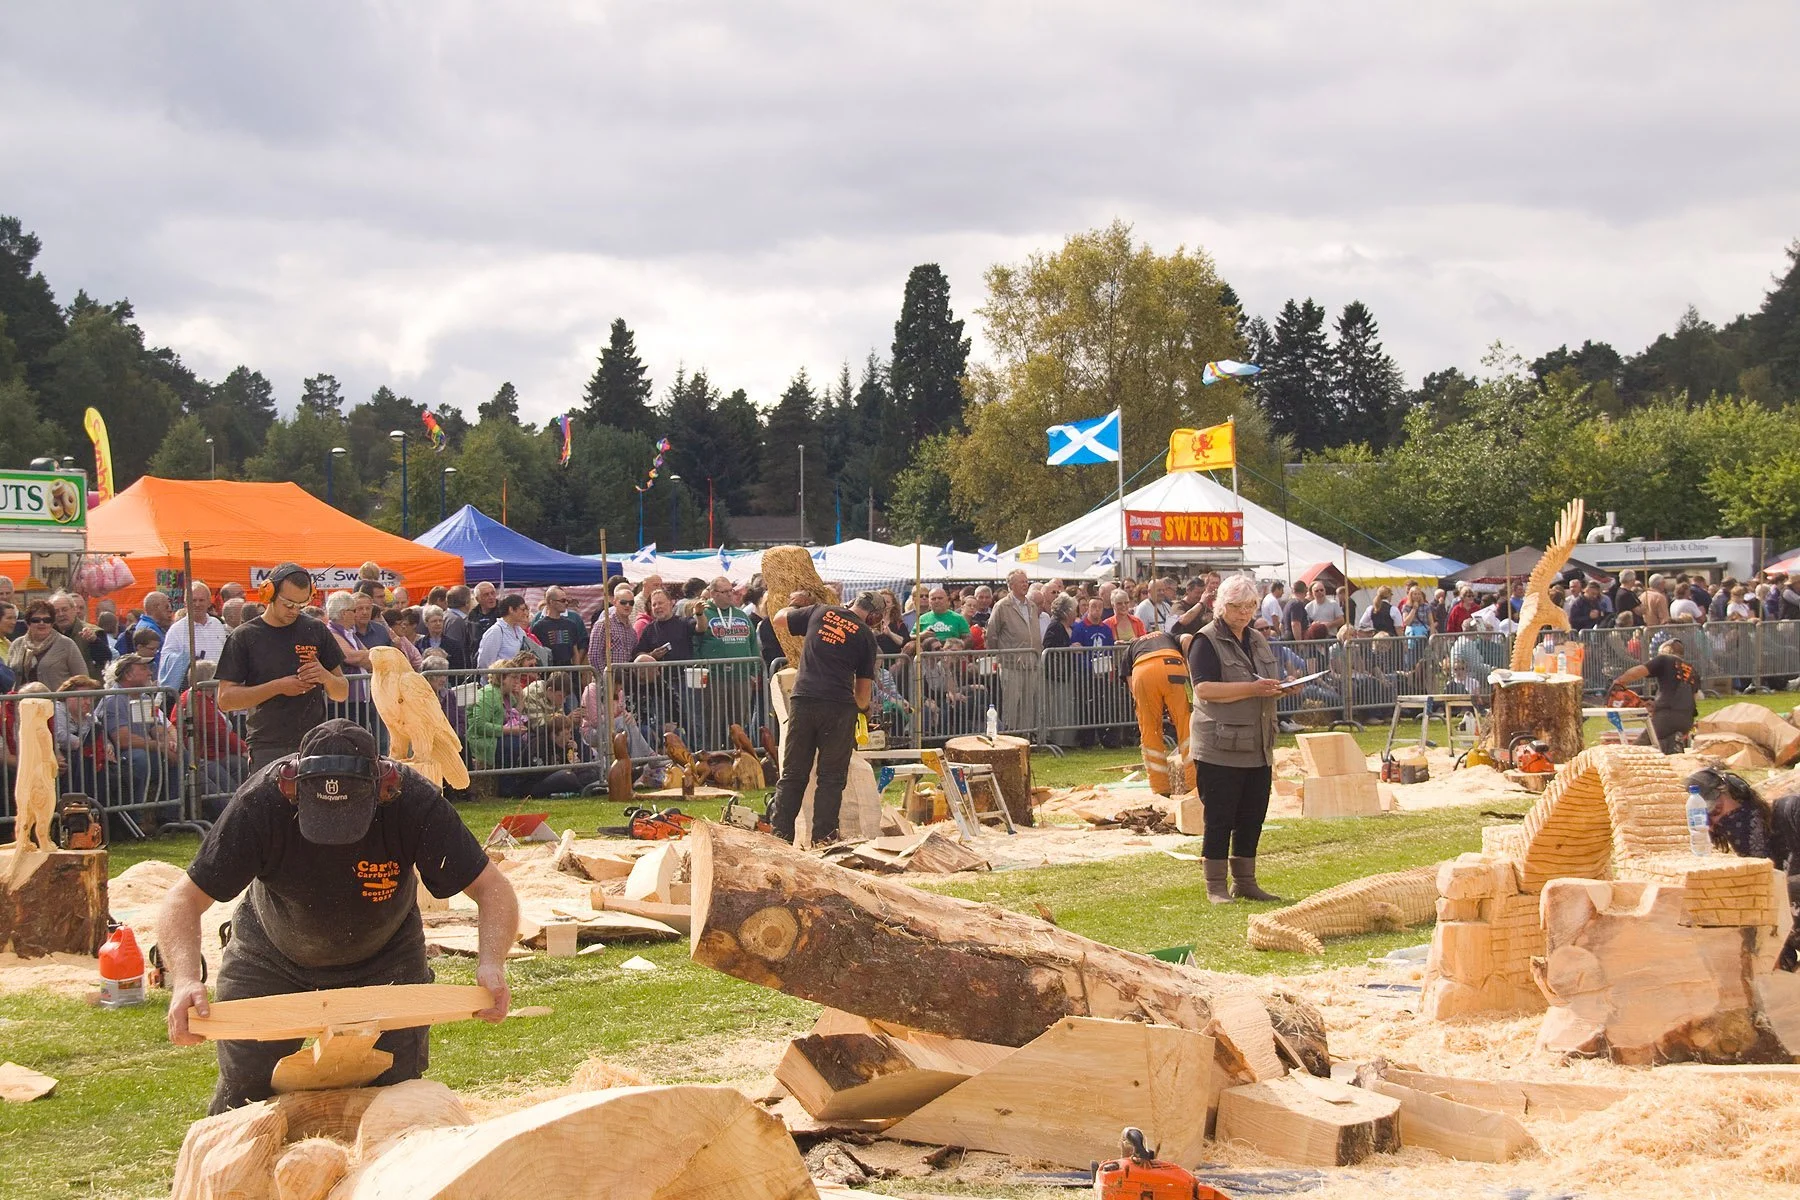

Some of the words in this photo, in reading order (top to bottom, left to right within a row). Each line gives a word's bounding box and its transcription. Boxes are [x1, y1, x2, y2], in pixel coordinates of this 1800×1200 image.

[1164, 515, 1229, 542] SWEETS
[1624, 543, 1662, 553] Tradional
[1663, 543, 1678, 552] Fish
[1680, 544, 1687, 552] &
[1688, 542, 1709, 554] Chips
[334, 570, 396, 581] Swts
[825, 611, 859, 631] Carve
[316, 792, 348, 801] Husqvarna
[357, 860, 399, 872] Carve
[362, 888, 397, 897] Scotlan
